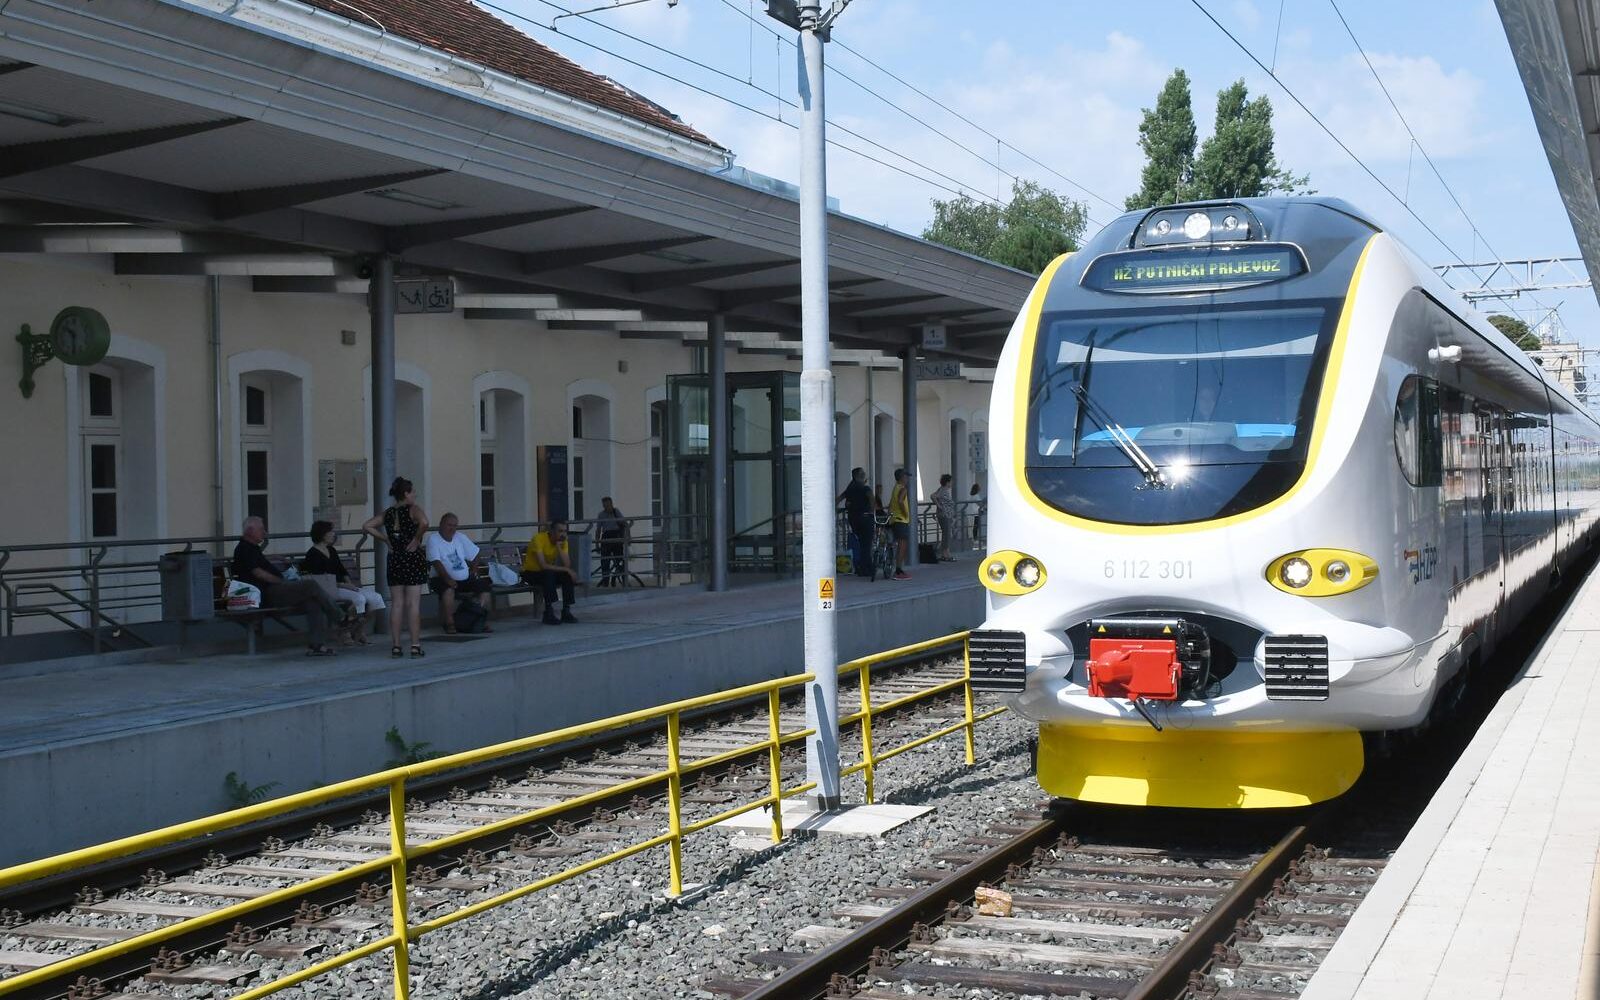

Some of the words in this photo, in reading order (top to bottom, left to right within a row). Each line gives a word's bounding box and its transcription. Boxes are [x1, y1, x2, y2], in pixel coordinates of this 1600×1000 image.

[1136, 262, 1205, 279] PUTNIČKI
[1209, 259, 1281, 275] PRIJEVOZ
[1104, 559, 1115, 579] 6
[1123, 559, 1150, 579] 112
[1159, 560, 1192, 579] 301
[822, 601, 832, 609] 23
